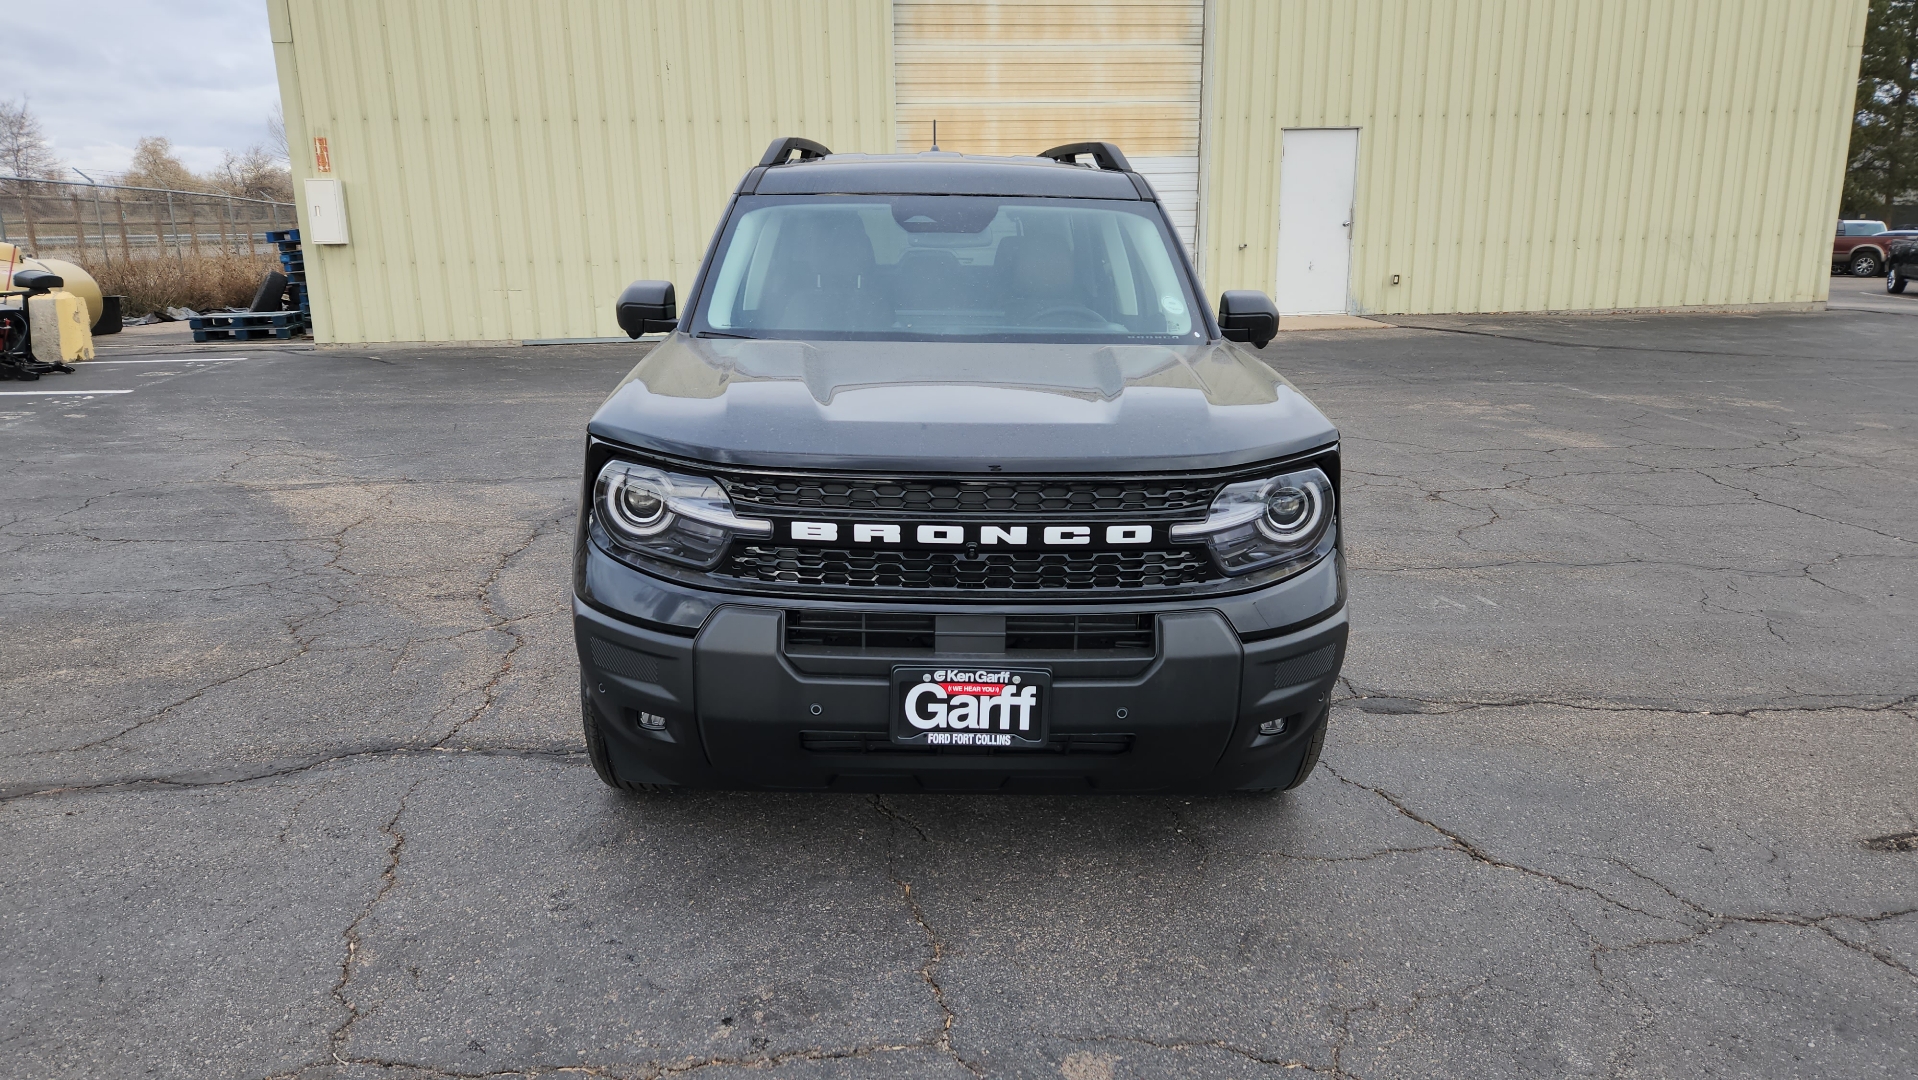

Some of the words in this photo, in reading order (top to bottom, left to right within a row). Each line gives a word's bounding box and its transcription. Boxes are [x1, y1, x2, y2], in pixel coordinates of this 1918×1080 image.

[791, 521, 1152, 545] BRONCO
[947, 669, 975, 682] Ken
[975, 671, 1010, 683] Garff
[905, 683, 1036, 731] Garff
[928, 733, 950, 744] FORD
[952, 734, 974, 745] FORT
[975, 734, 1011, 746] COLLINS
